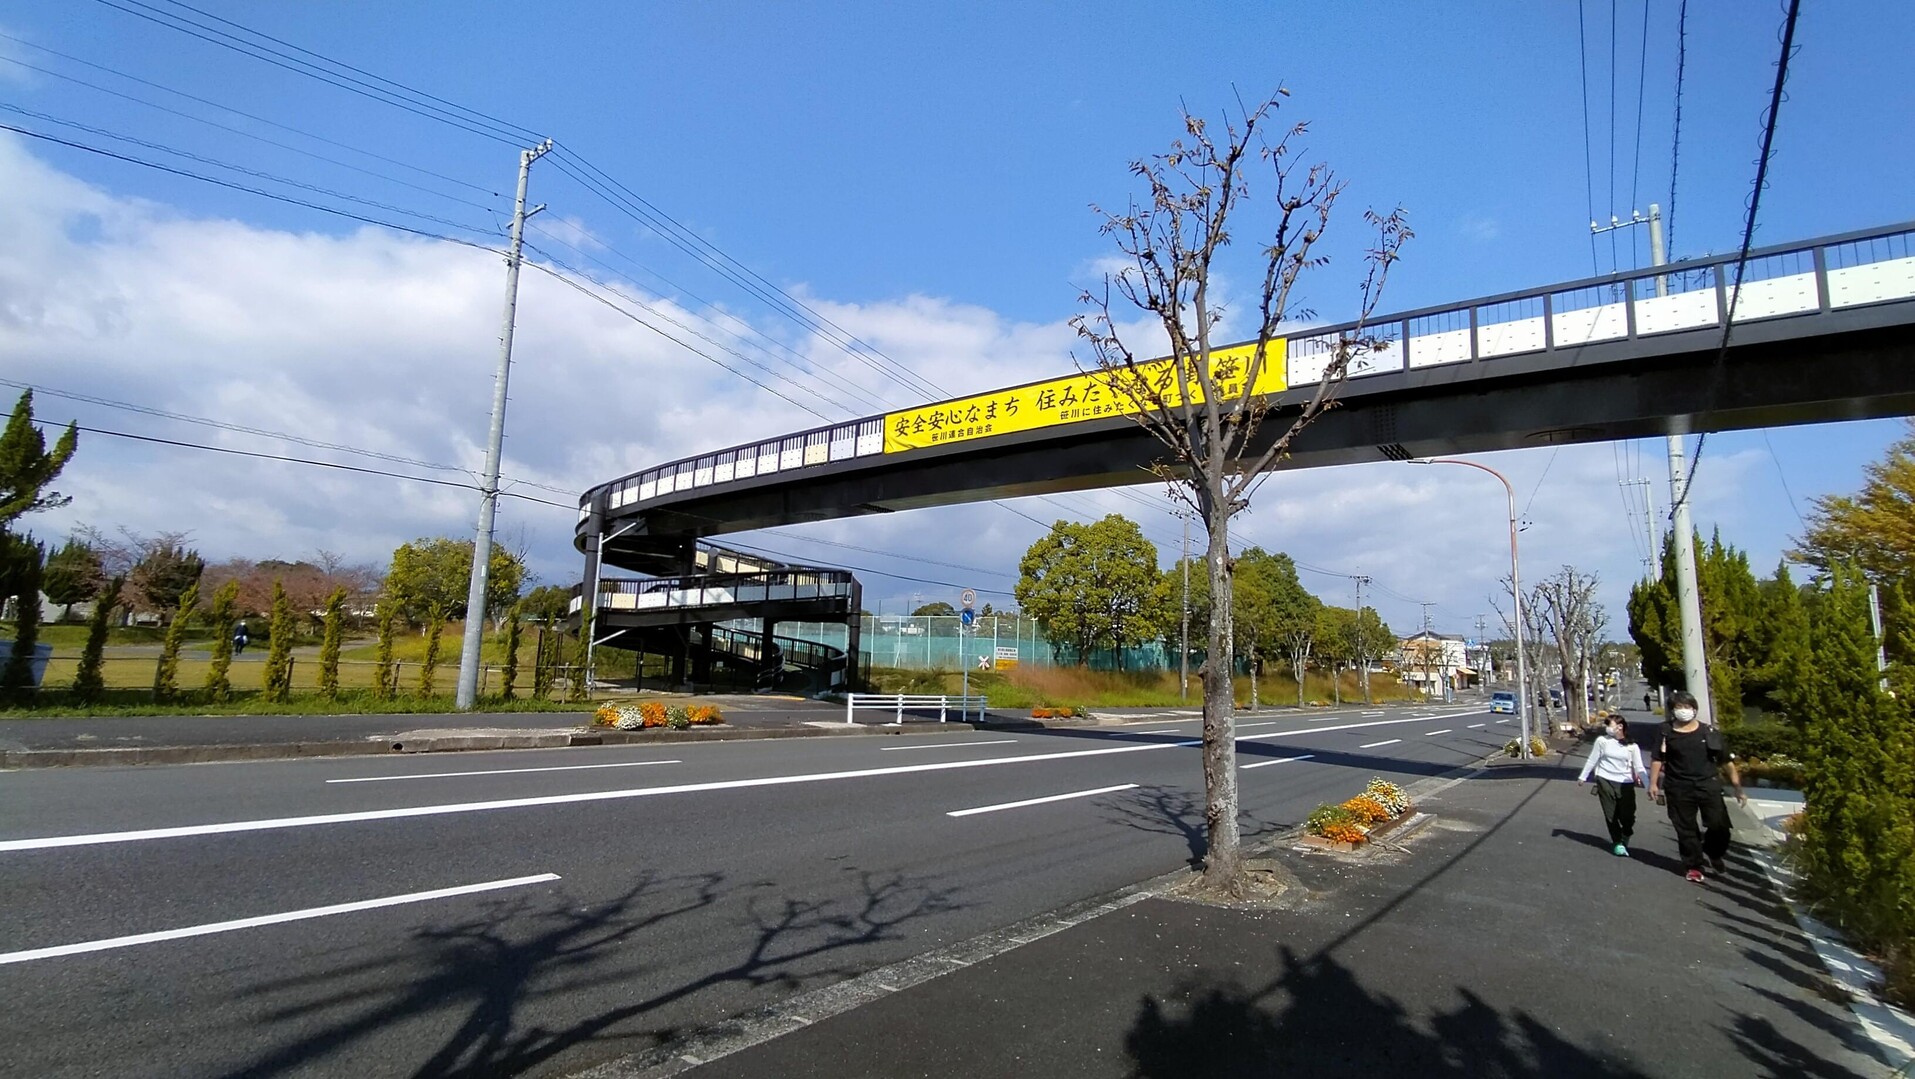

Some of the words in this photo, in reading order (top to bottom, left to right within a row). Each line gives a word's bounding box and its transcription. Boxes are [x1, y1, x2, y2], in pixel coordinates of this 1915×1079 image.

[894, 396, 1020, 437] 安全安心なまち
[931, 424, 993, 442] 笹川連合自治会
[963, 593, 973, 602] 40
